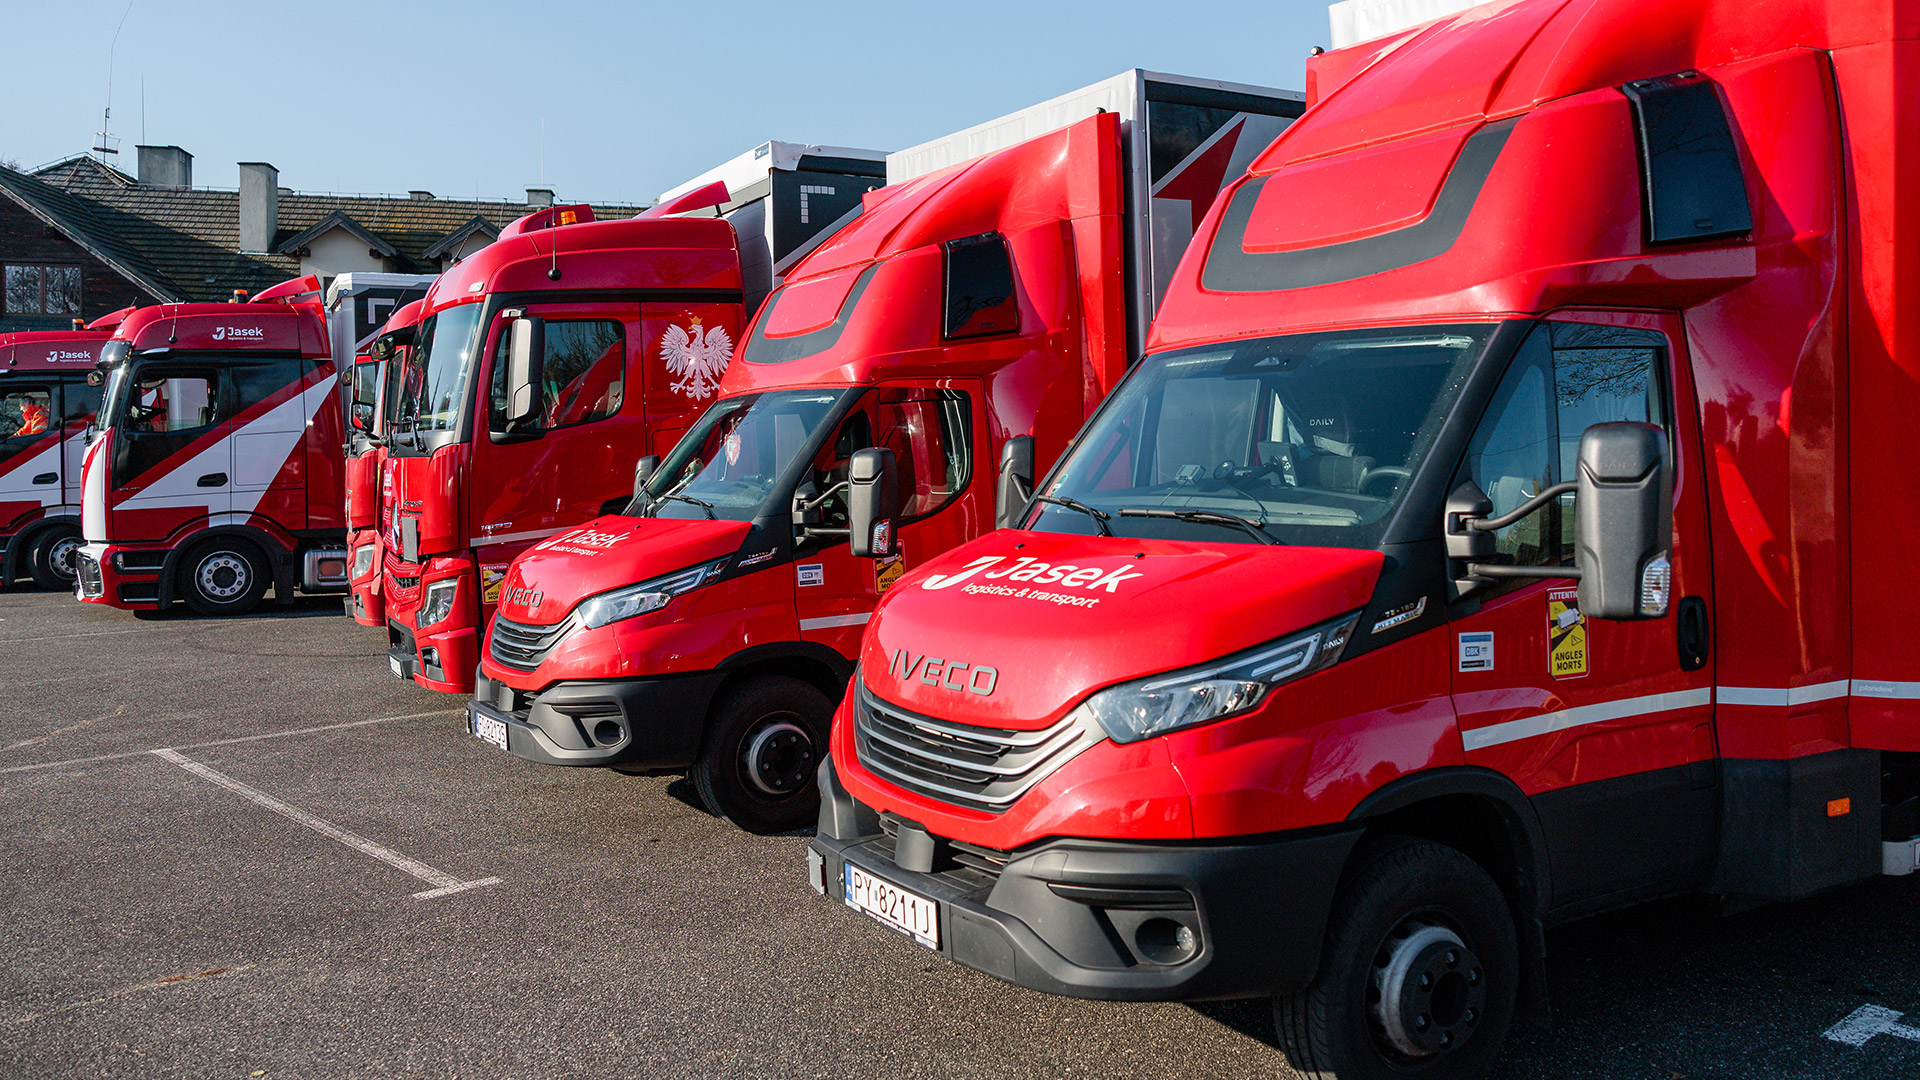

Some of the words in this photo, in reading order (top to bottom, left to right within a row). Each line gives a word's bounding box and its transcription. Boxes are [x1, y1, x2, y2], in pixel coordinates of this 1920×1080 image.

[227, 326, 264, 337] Jasek
[59, 350, 91, 359] Jasek
[1309, 418, 1335, 426] DAILY
[564, 529, 631, 548] Jasek
[984, 556, 1144, 594] Jasek
[503, 585, 544, 608] IVECO
[960, 582, 1014, 597] logistics
[1014, 587, 1024, 598] &
[1027, 589, 1100, 609] transport
[1549, 590, 1578, 601] ATTENTI
[1322, 636, 1345, 650] DAILY
[1466, 647, 1479, 656] DBK
[1555, 650, 1583, 662] ANGLES
[1556, 660, 1582, 671] MORTS
[888, 648, 999, 697] IVECO
